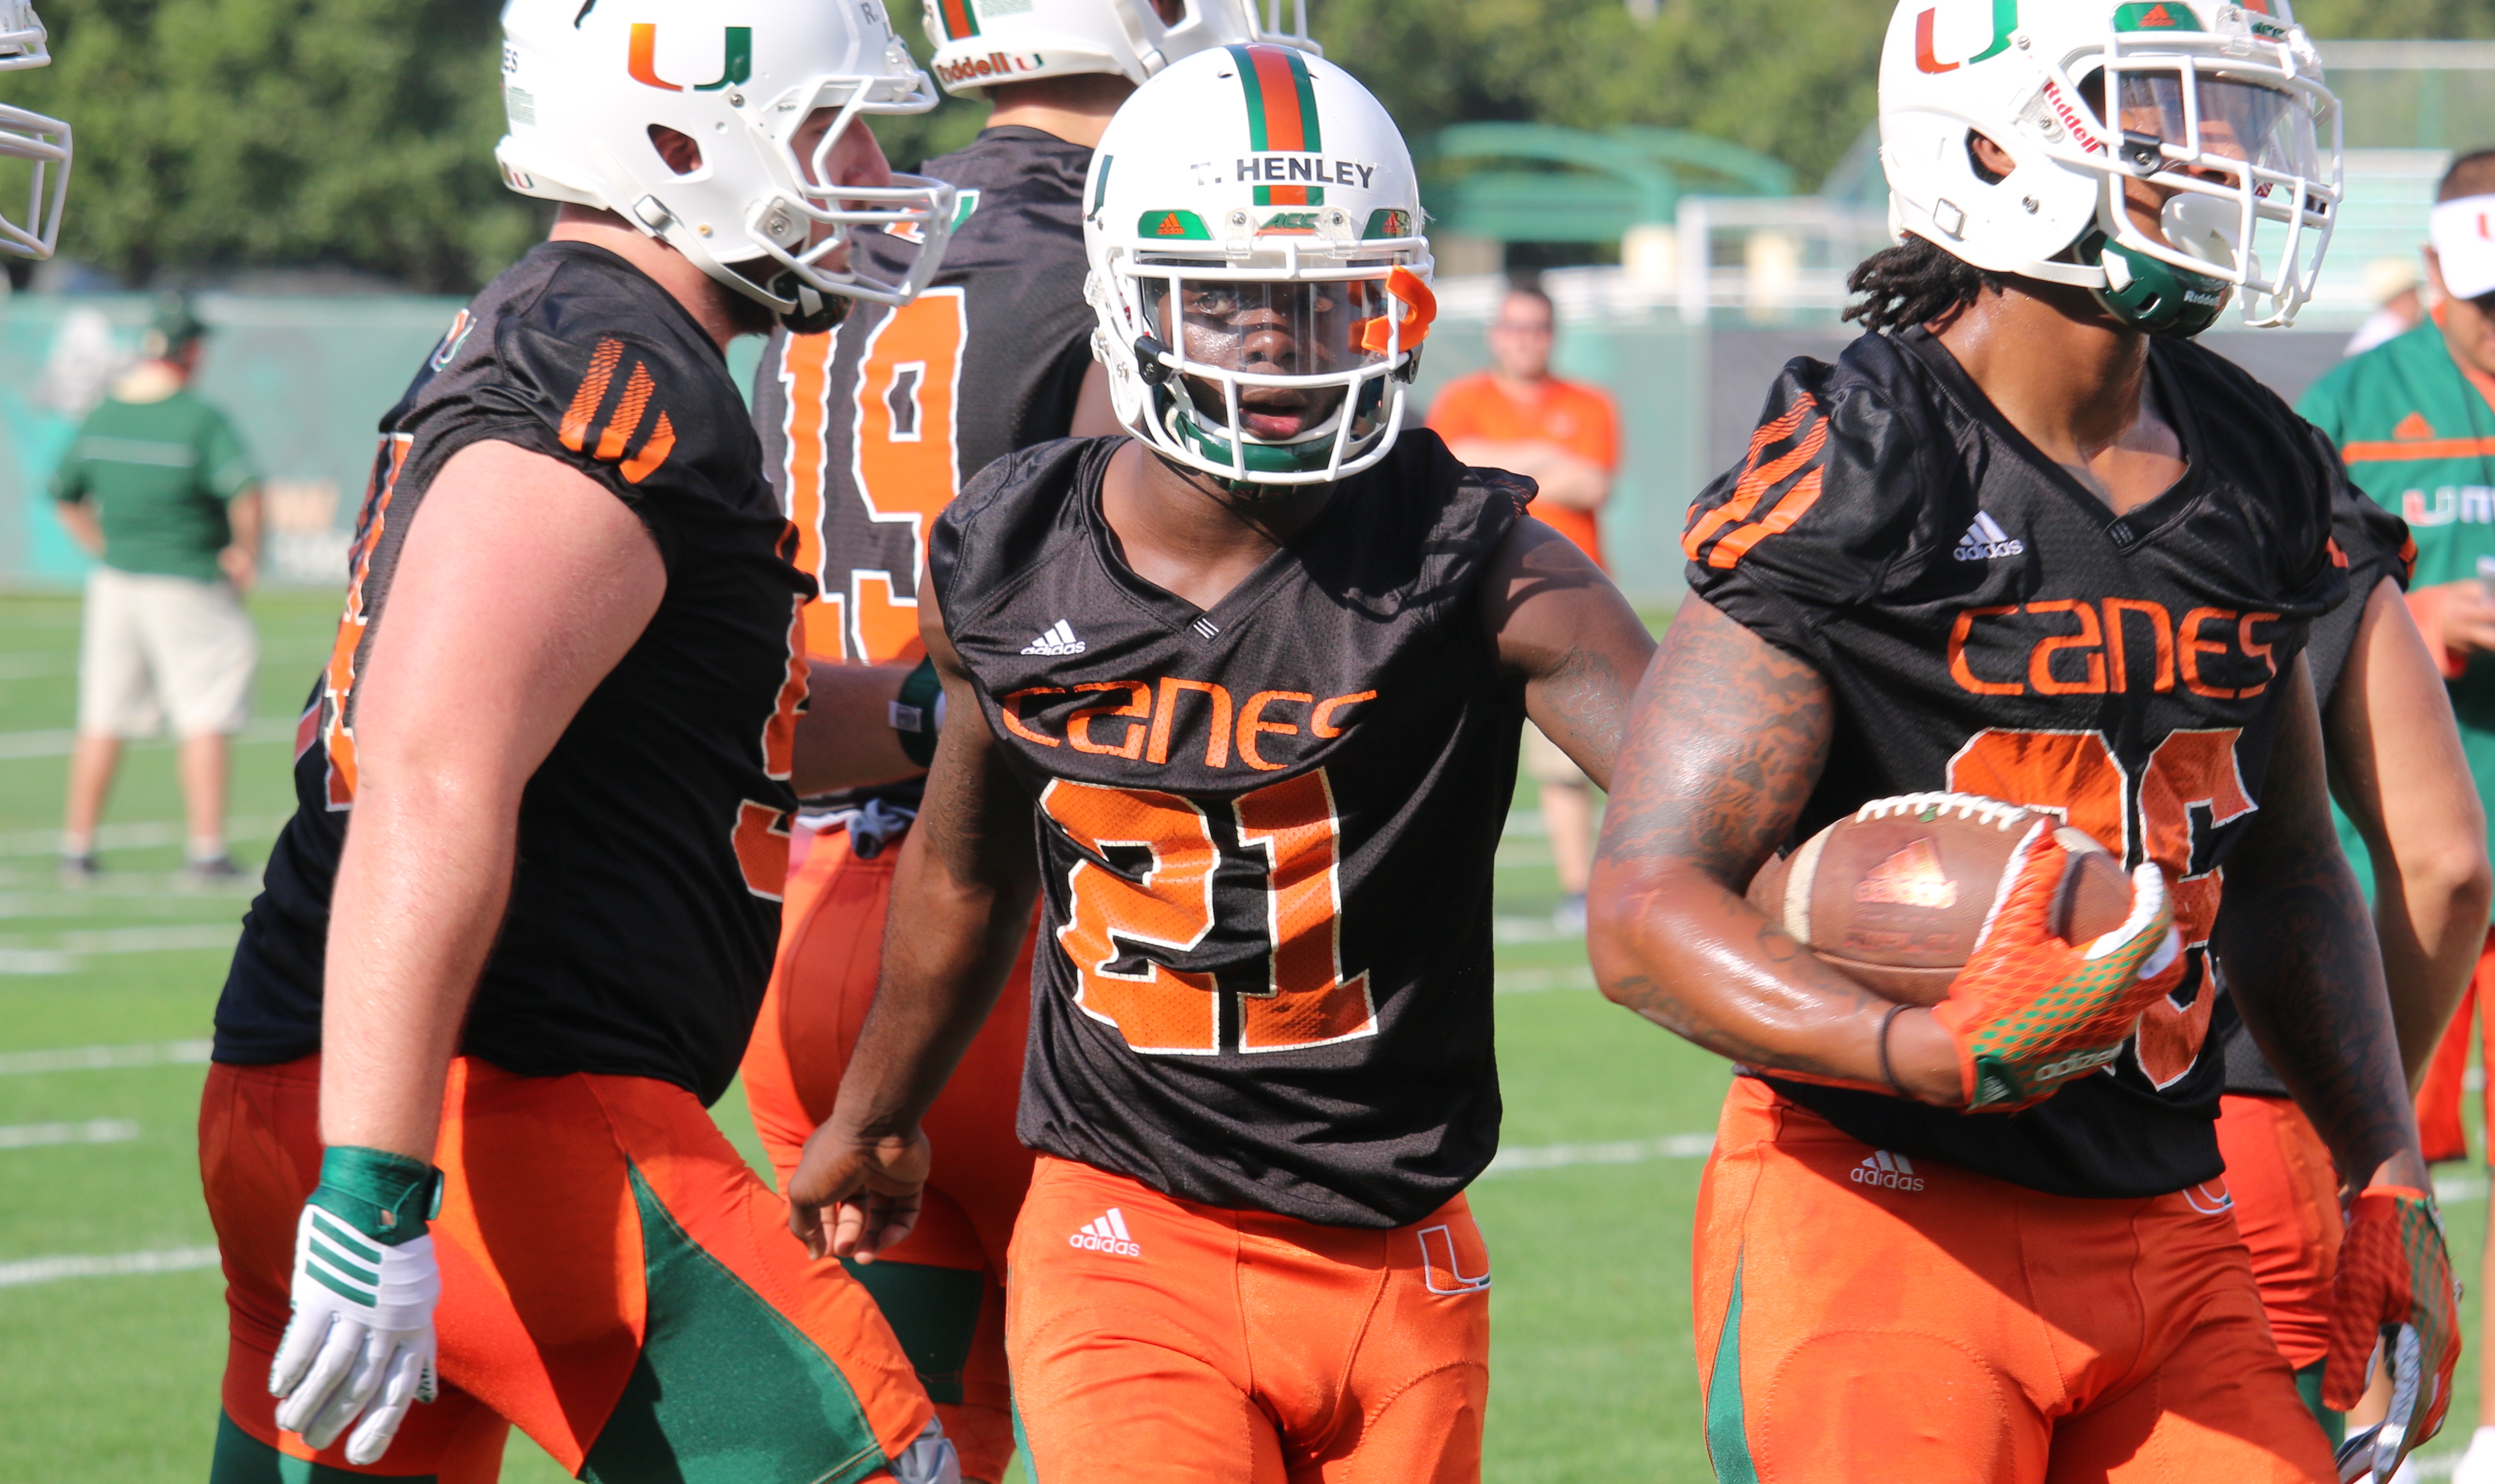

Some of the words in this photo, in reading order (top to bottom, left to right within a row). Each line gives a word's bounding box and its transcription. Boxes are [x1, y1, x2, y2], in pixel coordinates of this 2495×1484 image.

[628, 23, 753, 92] U
[1236, 157, 1374, 189] HENLEY
[1260, 212, 1322, 230] ACC
[1953, 538, 2024, 561] adidas
[1020, 640, 1086, 656] adidas
[1039, 765, 1378, 1056] 21
[1850, 1167, 1924, 1191] adidas
[1069, 1233, 1140, 1257] adidas
